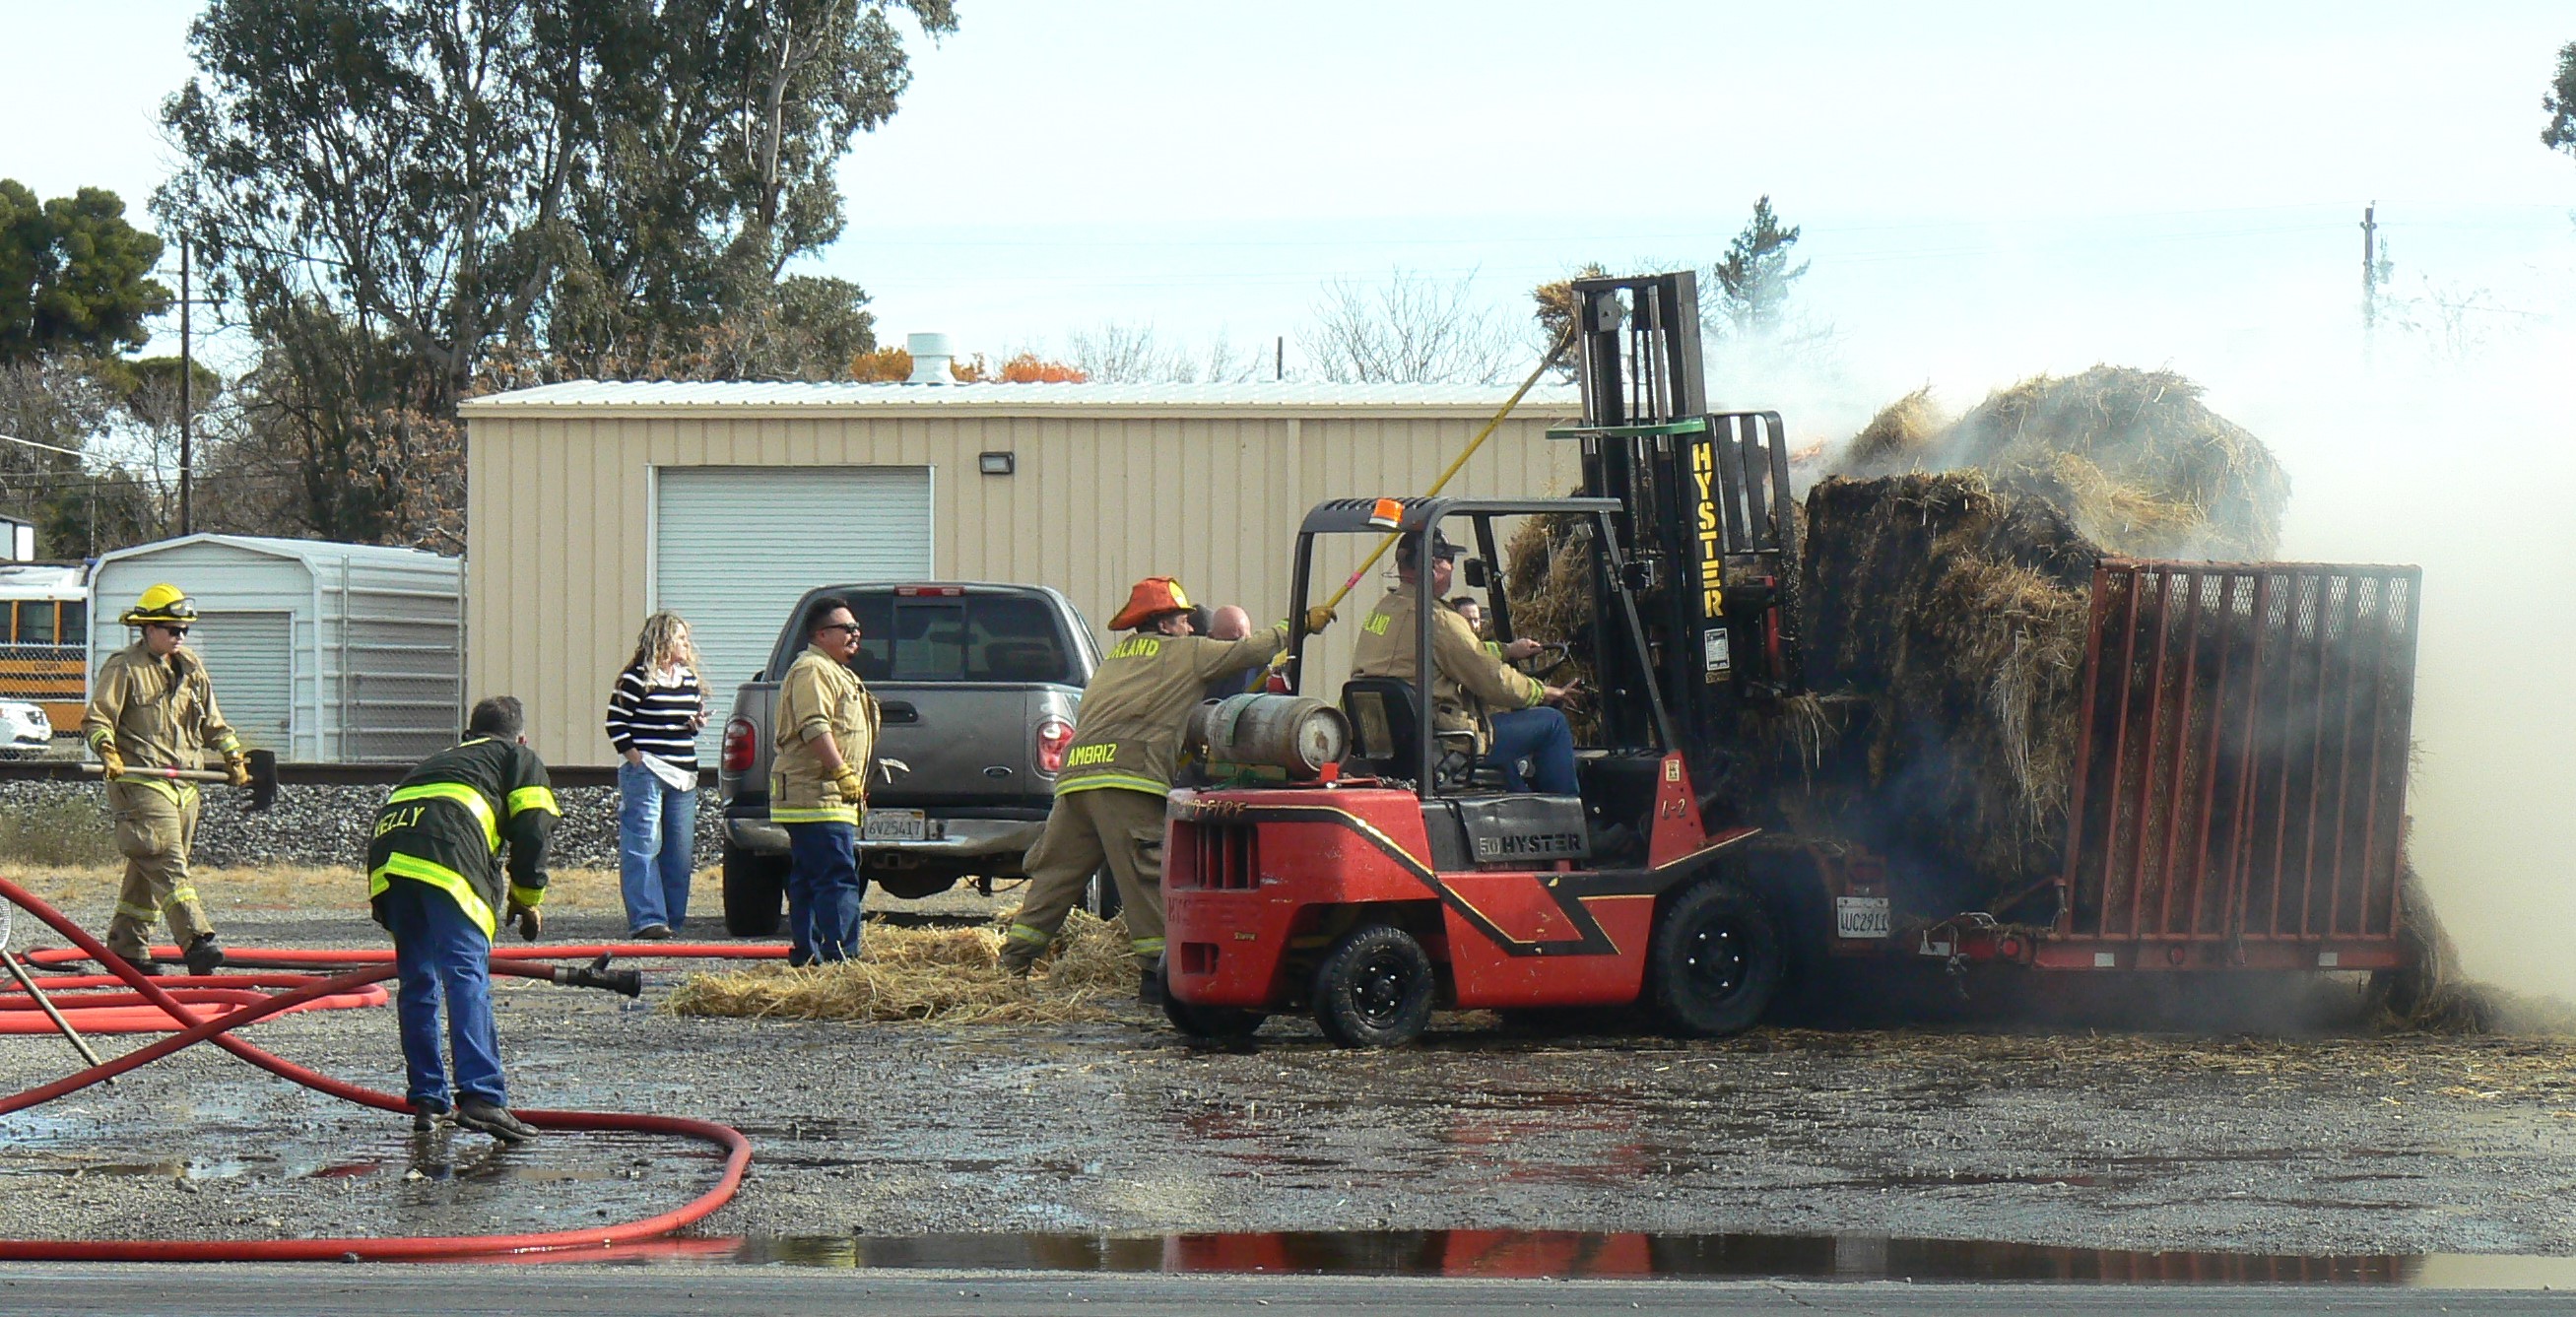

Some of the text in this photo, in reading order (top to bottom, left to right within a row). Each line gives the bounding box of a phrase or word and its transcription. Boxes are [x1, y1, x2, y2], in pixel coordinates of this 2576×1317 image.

[1691, 442, 1724, 618] HYSTER
[1066, 743, 1118, 767] AMBRIZ
[1501, 833, 1581, 853] HYSTER
